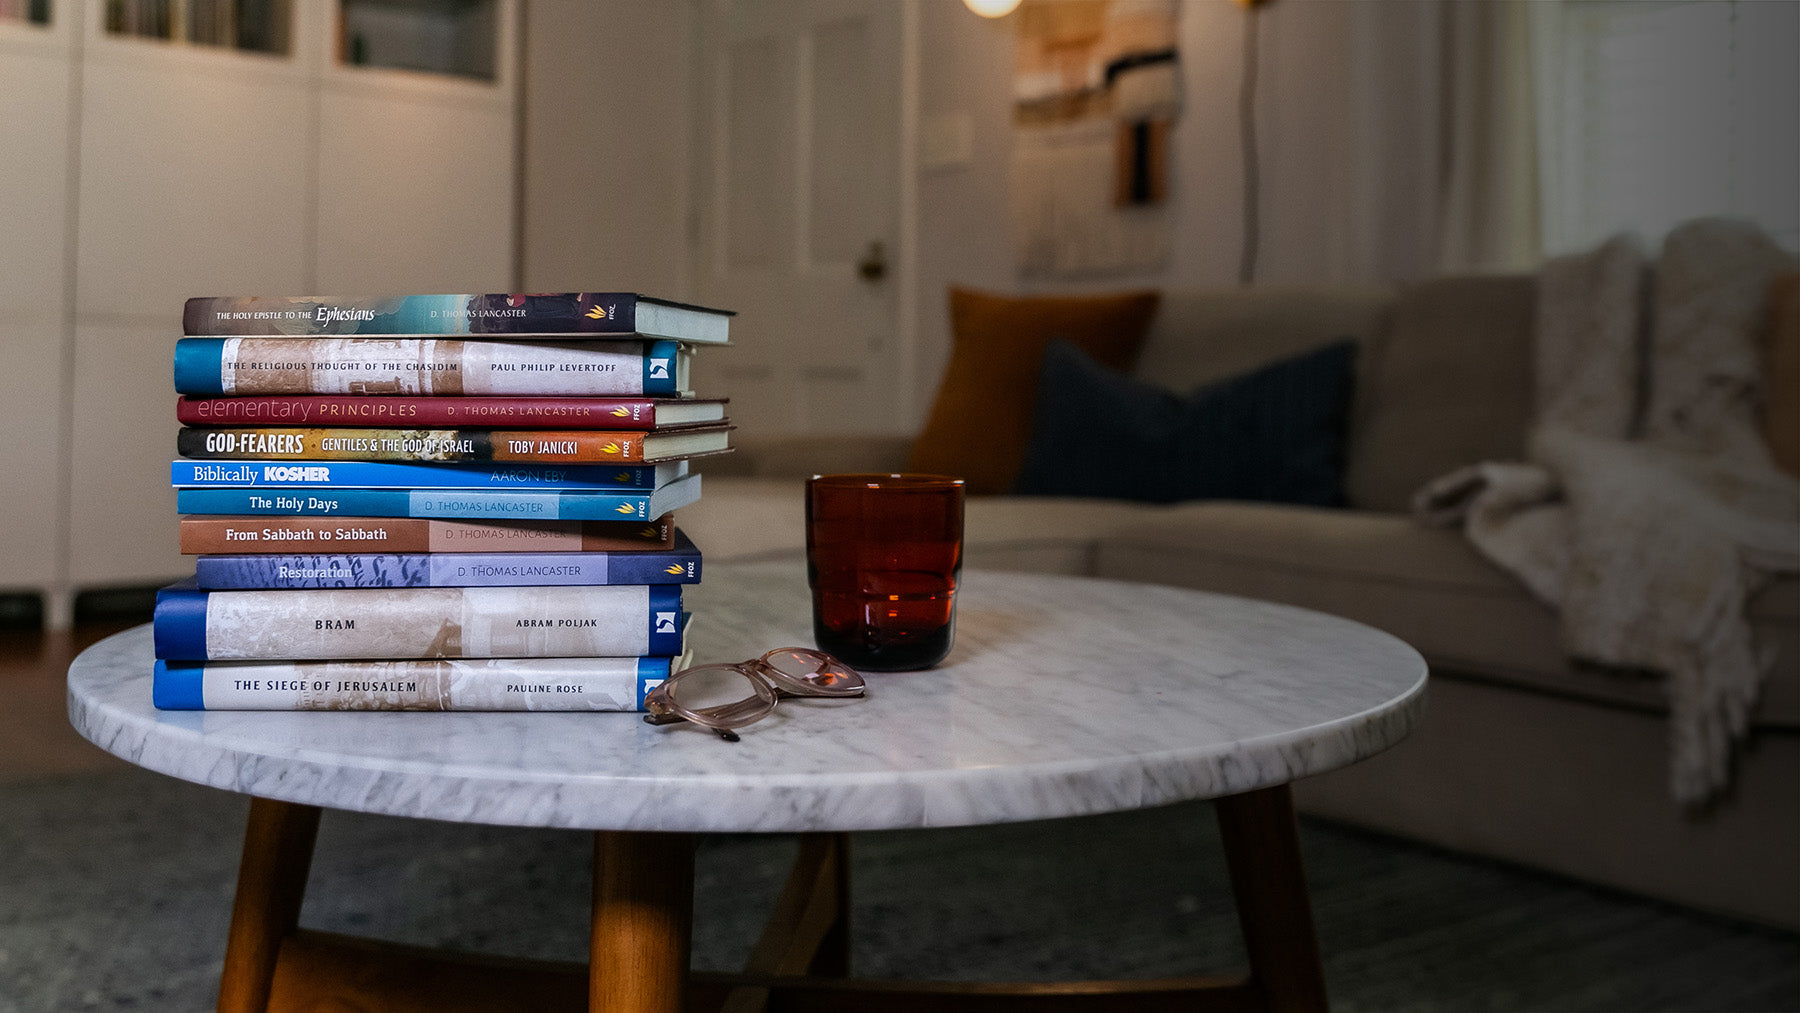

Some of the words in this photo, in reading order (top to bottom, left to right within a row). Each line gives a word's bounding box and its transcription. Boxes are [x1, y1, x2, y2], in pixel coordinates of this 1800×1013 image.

[285, 311, 295, 319] TO
[298, 311, 312, 319] THE
[316, 306, 375, 327] Ephesians
[430, 310, 439, 318] D.
[442, 310, 477, 318] THOMAS
[479, 309, 527, 317] LANCASTER
[228, 362, 246, 370] THE
[251, 362, 306, 370] RELIGIOUS
[311, 362, 359, 370] THOUGHT
[406, 363, 457, 371] CHASIDIM
[560, 364, 616, 372] LEVERTOFF
[198, 399, 312, 422] elementary
[320, 404, 417, 416] PRINCIPLES
[448, 407, 459, 415] D.
[465, 407, 514, 415] THOMAS
[520, 407, 590, 416] LANCASTER
[206, 433, 304, 454] GOD-FEARERS
[322, 438, 367, 451] GENTILES
[370, 438, 378, 451] &
[381, 439, 398, 451] THE
[402, 439, 421, 452] GOD
[425, 439, 438, 452] OF
[440, 439, 474, 453] ISRAEL
[509, 440, 534, 453] TOBY
[537, 441, 577, 454] JANICKI
[194, 466, 258, 485] Biblically
[264, 467, 330, 482] KOSHER
[491, 471, 540, 482] AARON
[545, 472, 566, 482] EBY
[250, 497, 272, 508] The
[276, 497, 304, 512] Holy
[309, 498, 338, 512] Days
[425, 502, 436, 510] D.
[439, 502, 482, 511] THOMAS
[485, 502, 543, 512] LANCASTER
[226, 529, 258, 541] From
[262, 528, 314, 540] Sabbath
[319, 529, 331, 540] to
[335, 528, 387, 540] Sabbath
[445, 530, 456, 539] D.
[460, 530, 504, 539] THOMAS
[507, 529, 566, 539] LANCASTER
[279, 566, 352, 579] Restoration
[458, 567, 469, 577] D.
[472, 566, 518, 576] THOMAS
[521, 566, 581, 576] LANCASTER
[315, 620, 355, 629] BRAM
[516, 619, 553, 627] ABRAM
[558, 619, 598, 627] POLJAK
[235, 680, 261, 690] THE
[267, 681, 306, 691] SIEGE
[314, 681, 331, 691] OF
[337, 681, 416, 692] JERUSALEM
[556, 685, 583, 693] ROSE
